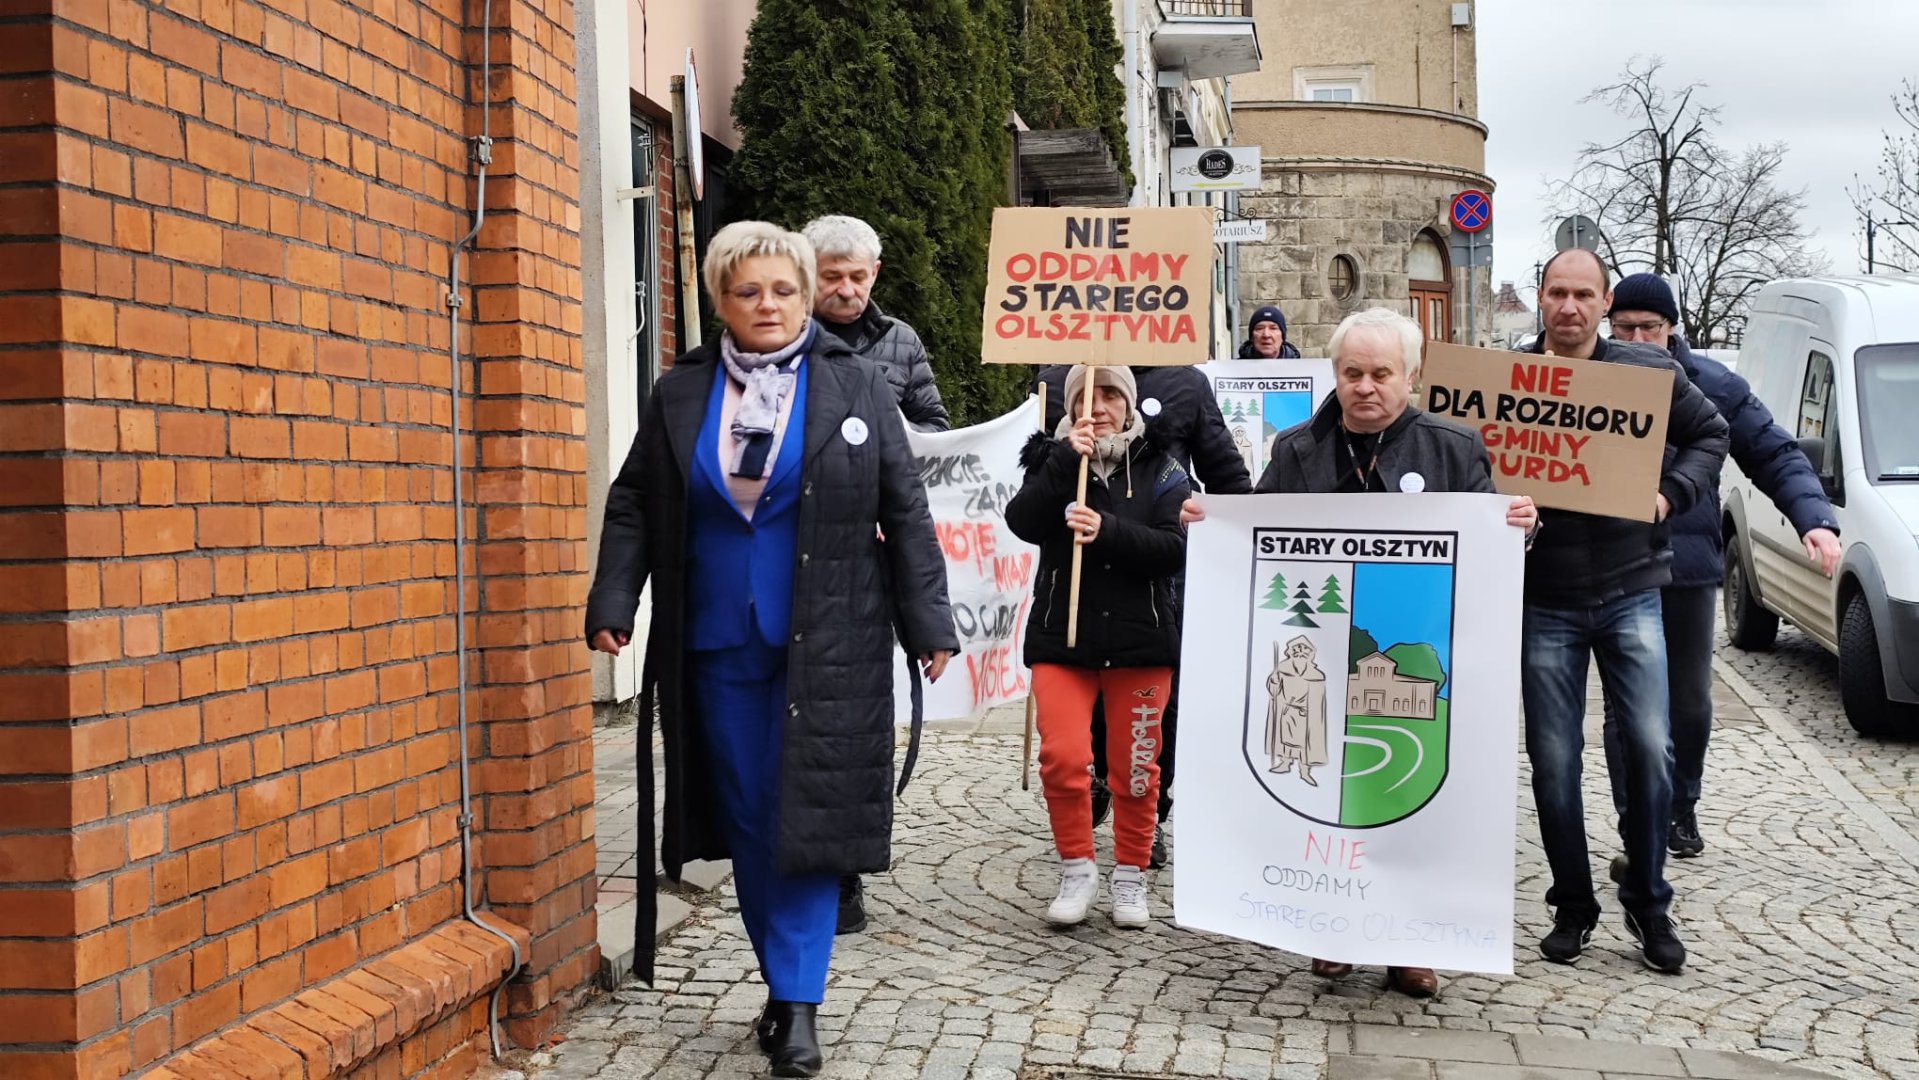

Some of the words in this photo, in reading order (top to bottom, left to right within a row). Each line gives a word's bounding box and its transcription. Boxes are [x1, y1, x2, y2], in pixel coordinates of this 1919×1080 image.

[1065, 217, 1130, 249] NIE
[1213, 226, 1263, 237] OTARIUSZ
[1006, 251, 1189, 283] ODDAMY
[1000, 283, 1189, 312] STAREGO
[995, 313, 1197, 343] OLSZTYNA
[1218, 380, 1254, 390] STARY
[1258, 381, 1309, 390] OLSZTYN
[1511, 363, 1573, 397] NIE
[1428, 385, 1486, 419] DLA
[1495, 393, 1654, 439] ROZBIORU
[1480, 423, 1592, 460] GMINY
[1260, 536, 1336, 555] STARY
[1342, 538, 1449, 558] OLSZTYN
[1305, 830, 1368, 870] NIE
[1262, 865, 1372, 901] ODDAMY
[1235, 891, 1350, 933] STAREGO
[1362, 911, 1497, 950] OLSZTYNA
